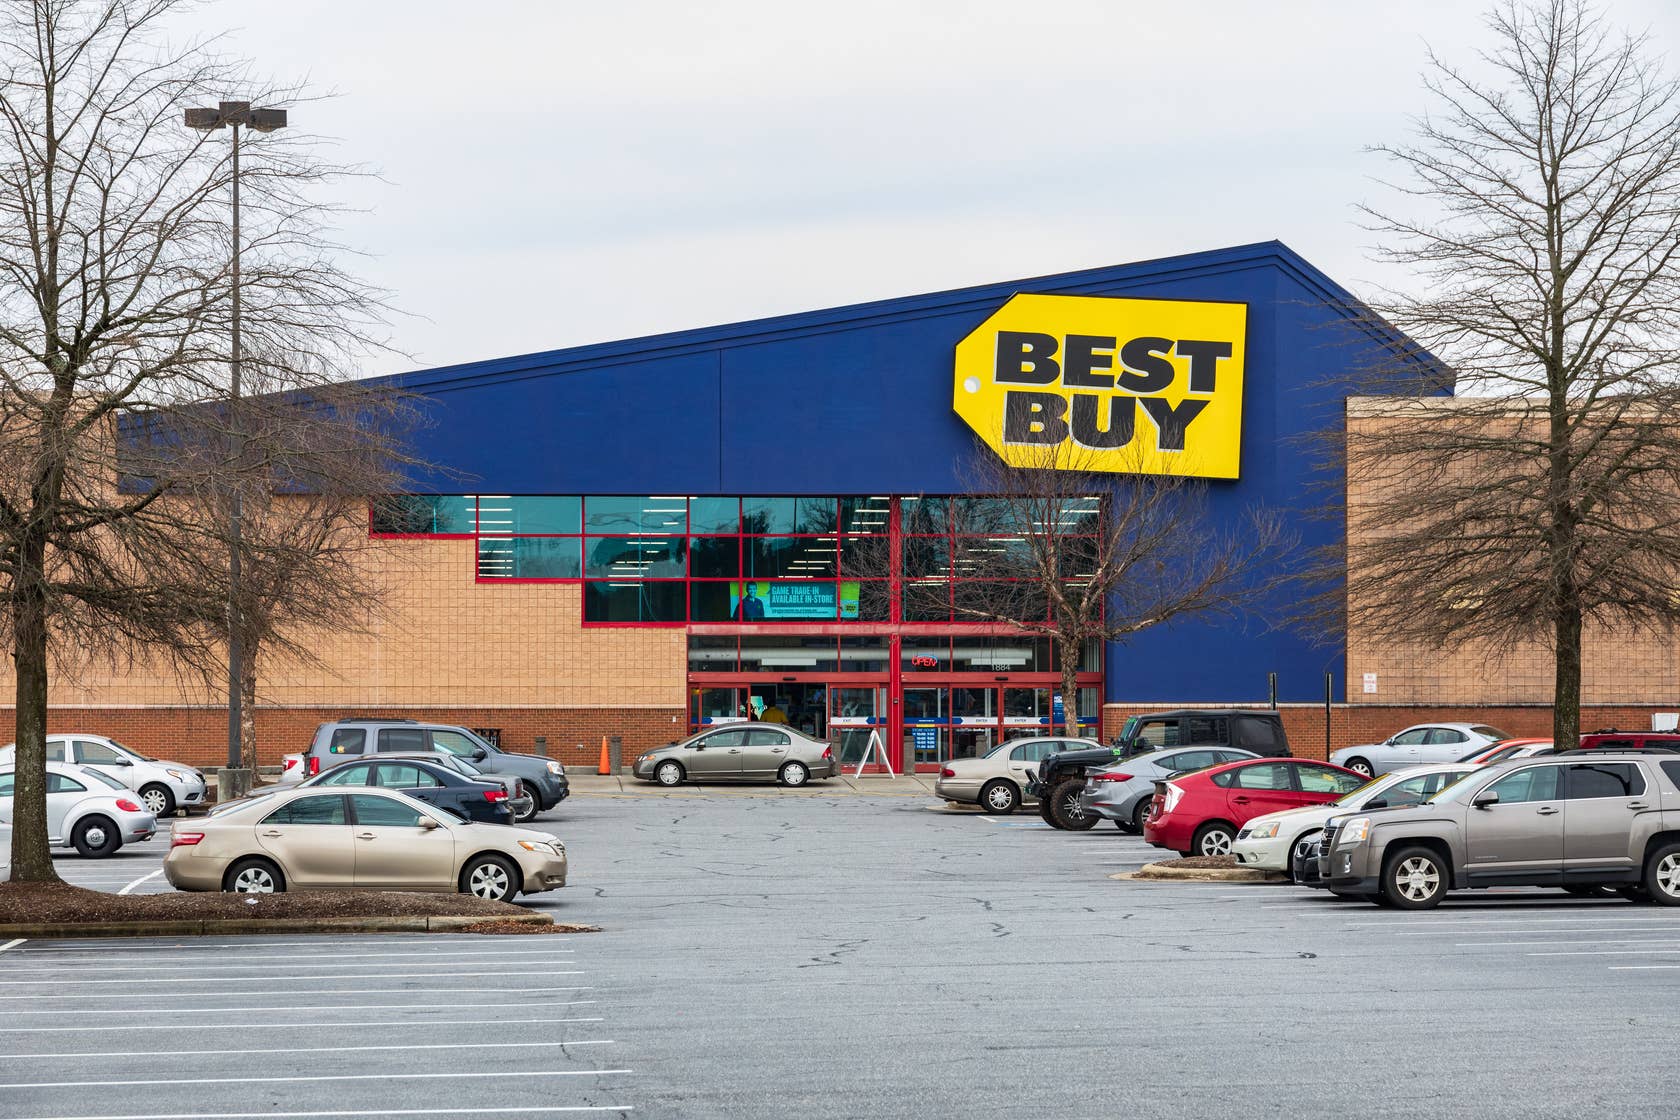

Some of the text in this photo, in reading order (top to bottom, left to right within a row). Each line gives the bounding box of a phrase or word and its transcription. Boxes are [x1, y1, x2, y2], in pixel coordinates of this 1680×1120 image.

[995, 331, 1233, 394] BEST
[1003, 391, 1211, 453] BUY
[771, 586, 819, 595] GAME TRADE-IN
[771, 594, 834, 604] AVAILABLE IN-STORE
[912, 656, 937, 667] OPEN
